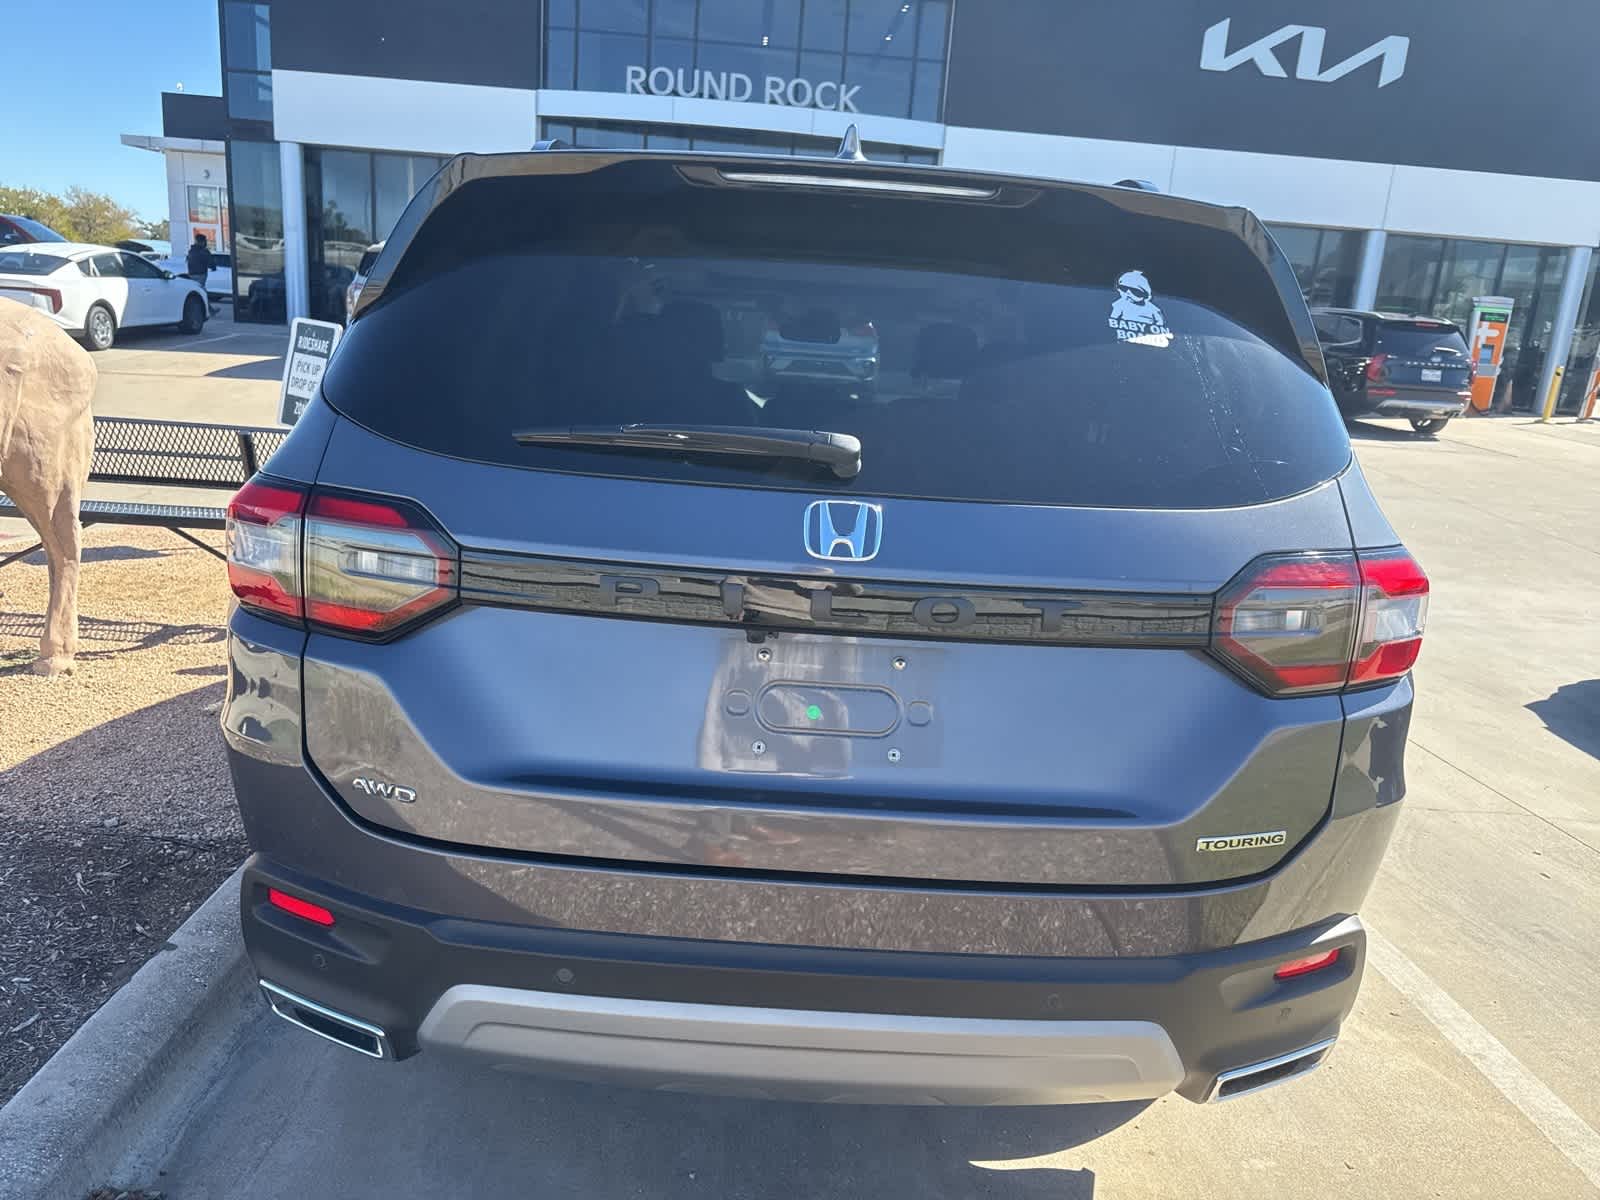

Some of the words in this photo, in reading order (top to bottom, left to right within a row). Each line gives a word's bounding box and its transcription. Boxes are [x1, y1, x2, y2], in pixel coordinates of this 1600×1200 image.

[1200, 17, 1410, 89] KIA
[625, 65, 752, 102] ROUND
[764, 76, 862, 113] ROCK
[1108, 318, 1147, 333] BABY
[1150, 324, 1170, 336] ON
[296, 360, 310, 374] PICK
[311, 364, 321, 376] UP
[291, 375, 307, 391] DROP
[308, 380, 318, 392] OF
[600, 574, 1084, 633] PILOT
[352, 776, 417, 803] AWD
[1201, 834, 1284, 850] TOURING
